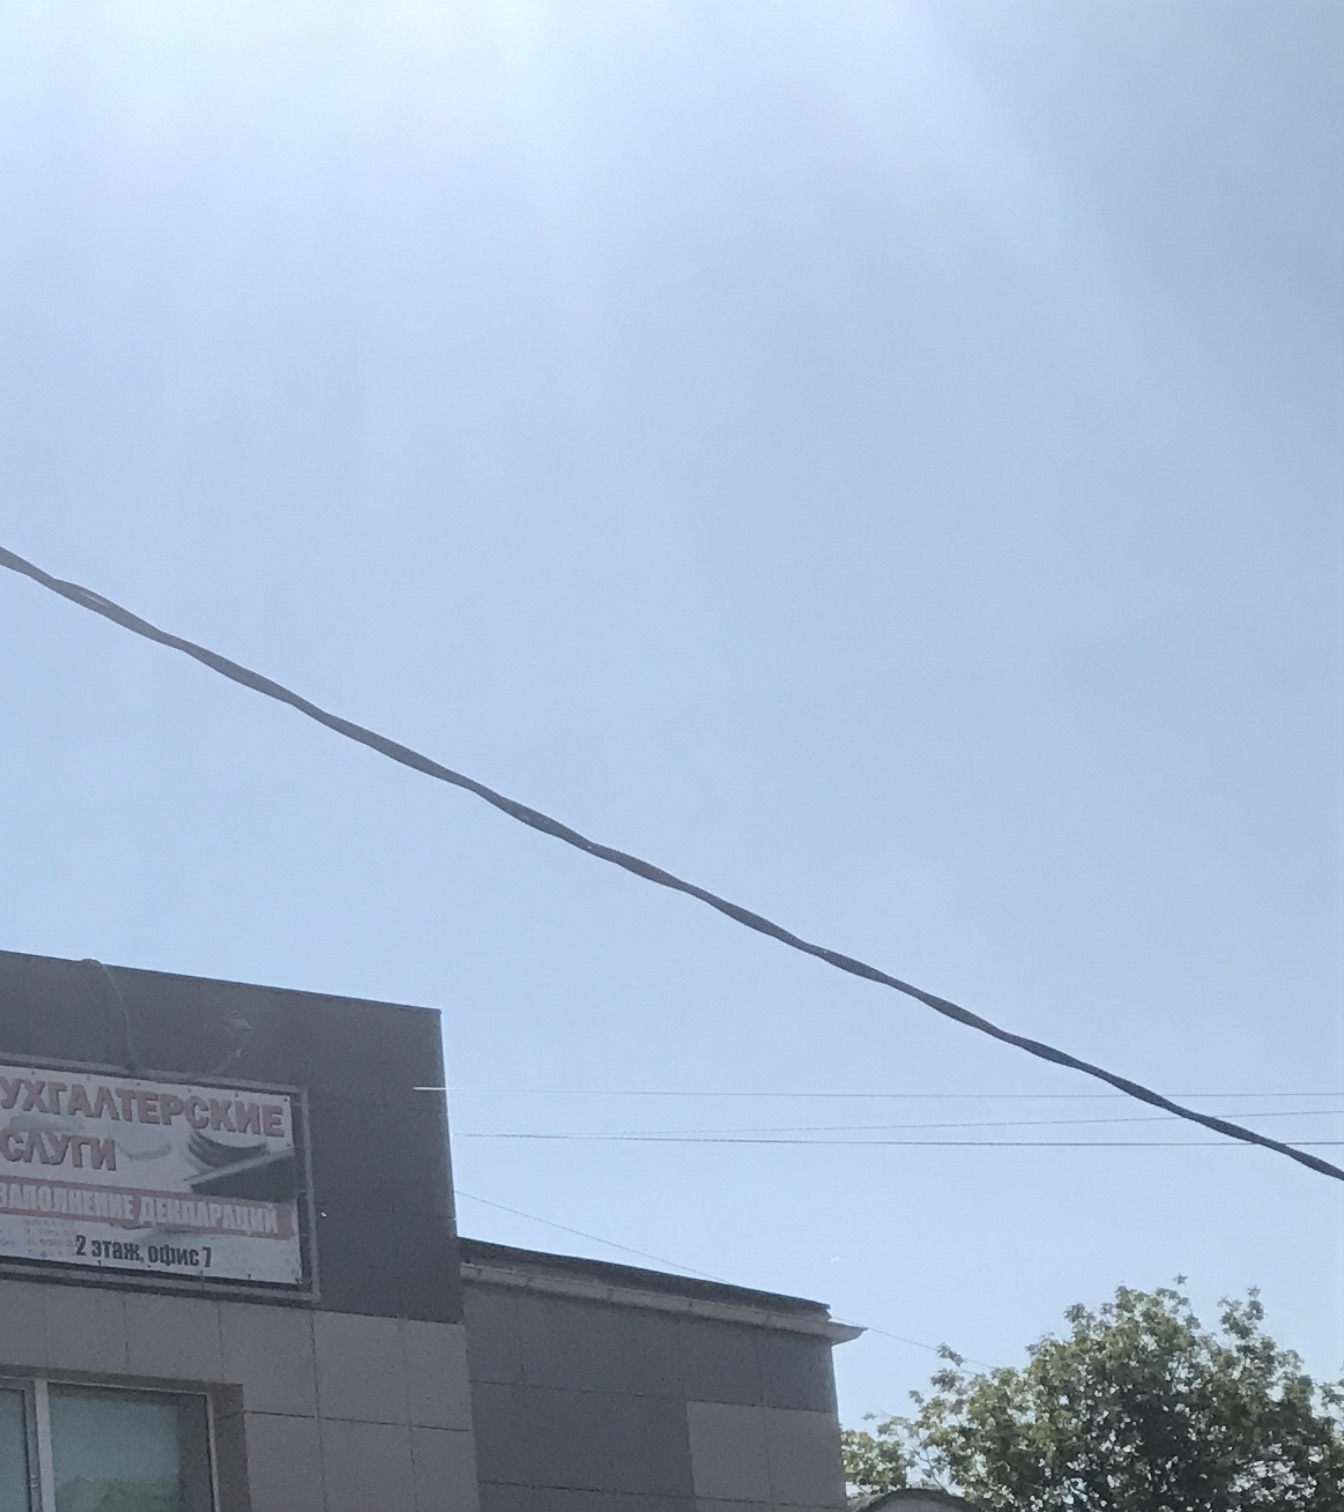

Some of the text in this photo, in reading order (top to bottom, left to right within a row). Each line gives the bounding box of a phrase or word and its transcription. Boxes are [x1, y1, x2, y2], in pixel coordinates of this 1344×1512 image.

[138, 1196, 279, 1236] ДЕКЛАРАЦИЙ
[75, 1235, 86, 1257] 2
[91, 1238, 144, 1264] этаж,
[147, 1243, 199, 1268] офис
[203, 1246, 212, 1268] 7
